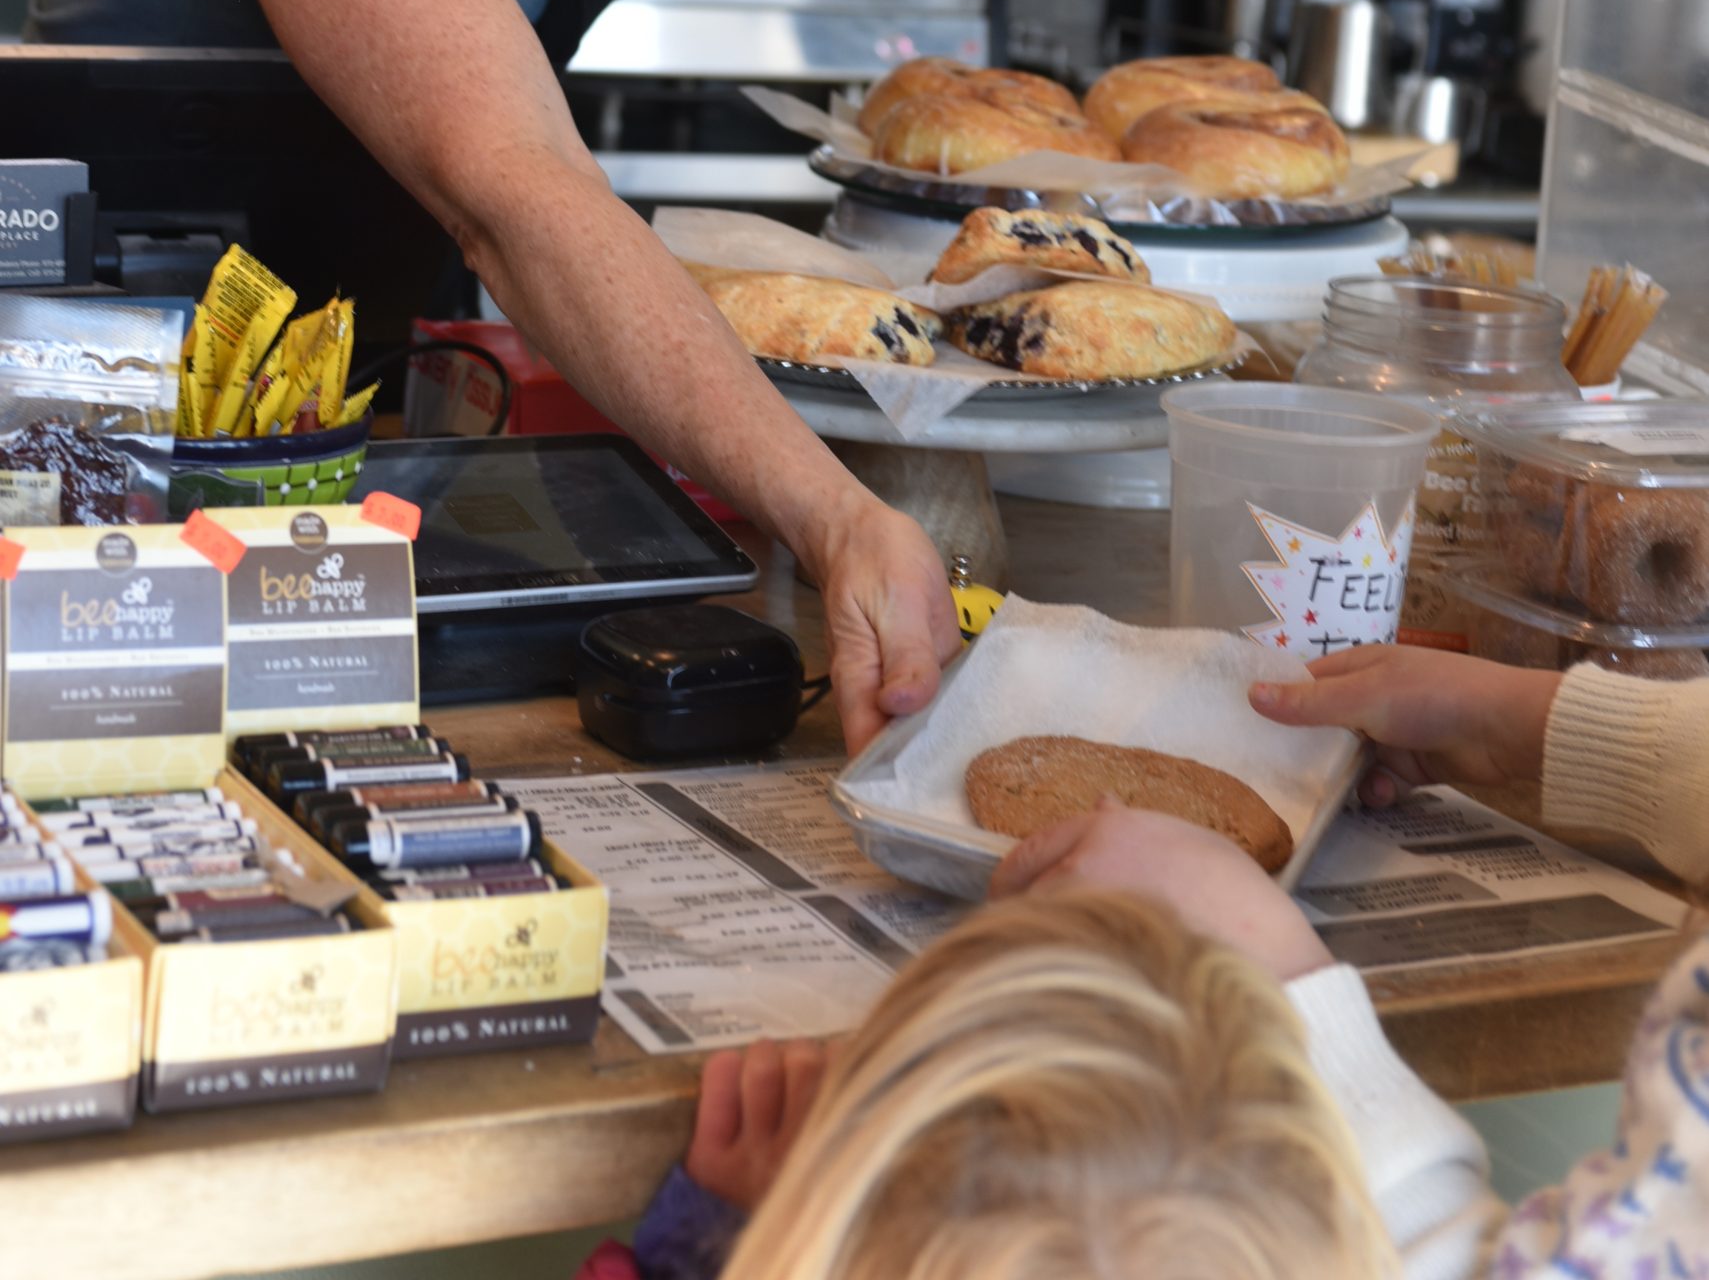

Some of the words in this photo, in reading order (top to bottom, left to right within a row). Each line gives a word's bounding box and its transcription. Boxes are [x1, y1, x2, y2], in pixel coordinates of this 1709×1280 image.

[260, 566, 315, 601] bee
[60, 591, 118, 629] bee
[262, 601, 298, 615] LIP
[308, 598, 367, 614] BALM
[61, 627, 100, 642] LIP
[112, 625, 175, 641] BALM
[264, 656, 303, 671] 100%
[309, 654, 368, 669] NATURAL
[61, 686, 103, 701] 100%
[109, 685, 175, 700] NATURAL
[410, 1022, 470, 1045] 100%
[479, 1014, 569, 1038] NATURAL
[185, 1070, 250, 1096] 100%
[260, 1062, 357, 1088] NATURAL
